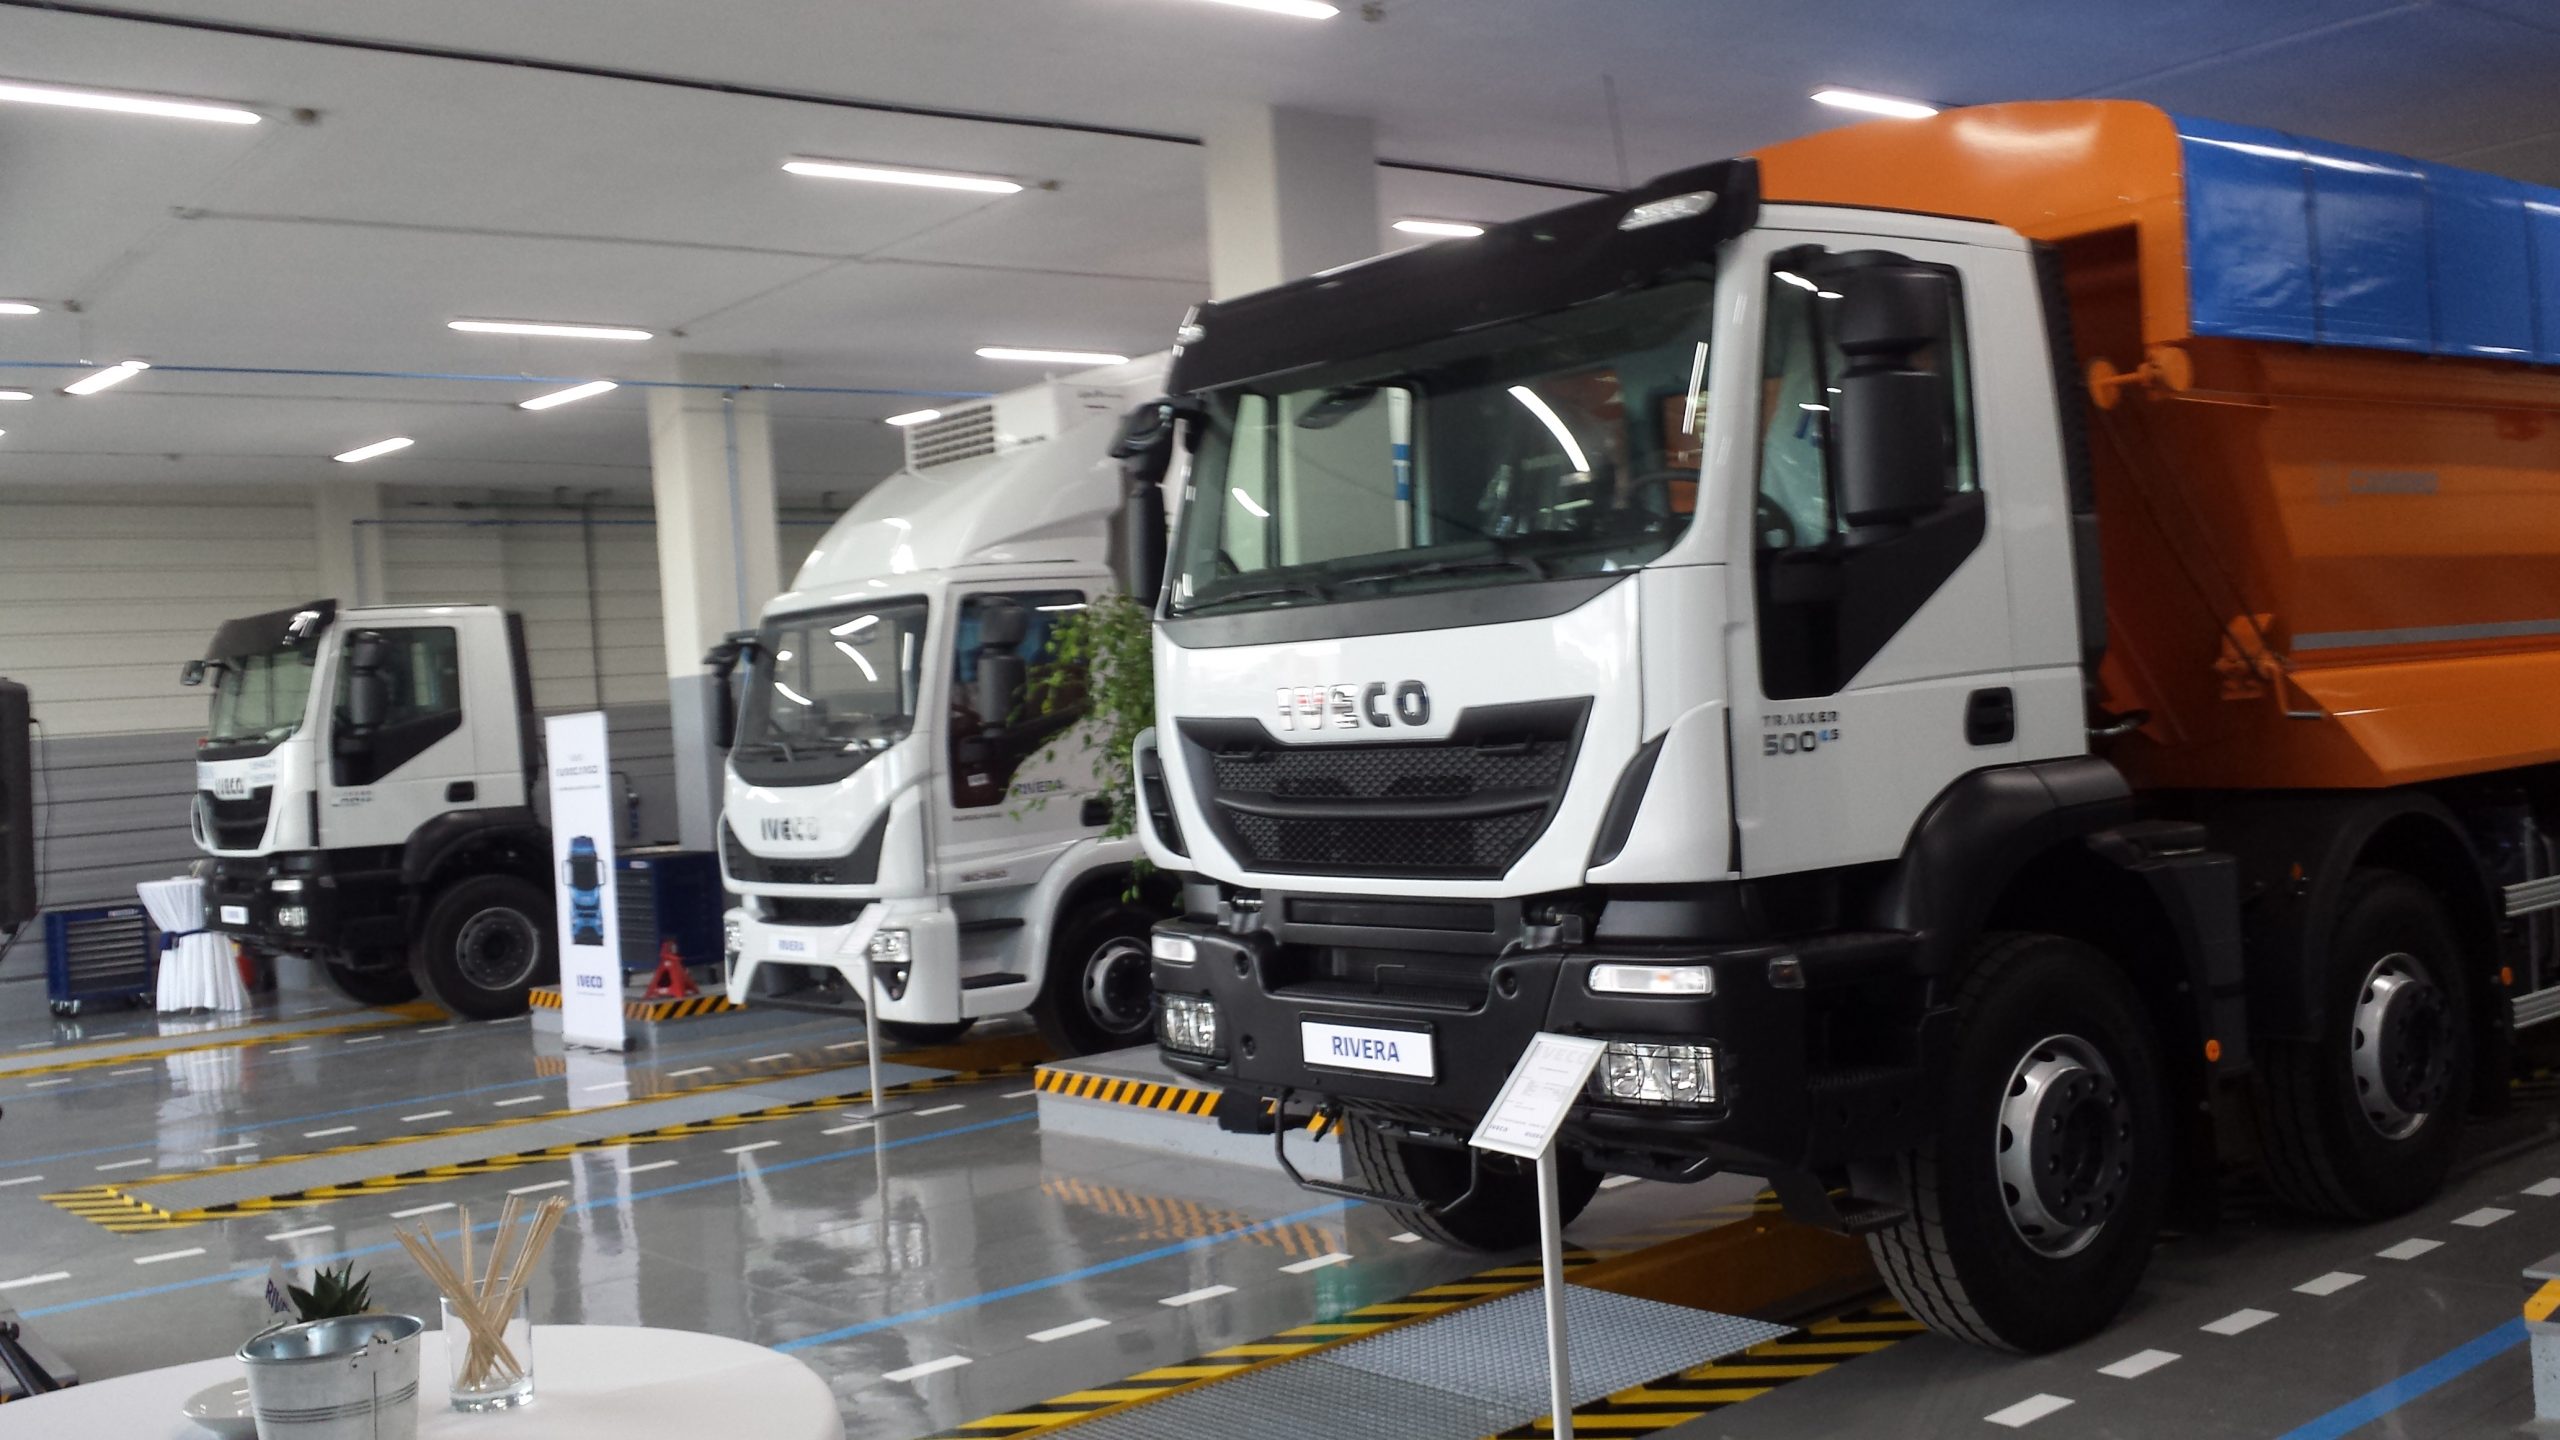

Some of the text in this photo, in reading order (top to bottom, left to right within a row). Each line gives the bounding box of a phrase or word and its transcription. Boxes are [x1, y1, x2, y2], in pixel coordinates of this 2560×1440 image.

[1276, 679, 1431, 732] IVECO
[1762, 710, 1840, 728] TRAKKER
[1762, 730, 1816, 756] 500
[1015, 779, 1066, 795] RIVEA
[760, 816, 818, 841] IVECO
[576, 974, 603, 989] IVECO
[1331, 1035, 1401, 1062] RIVERA
